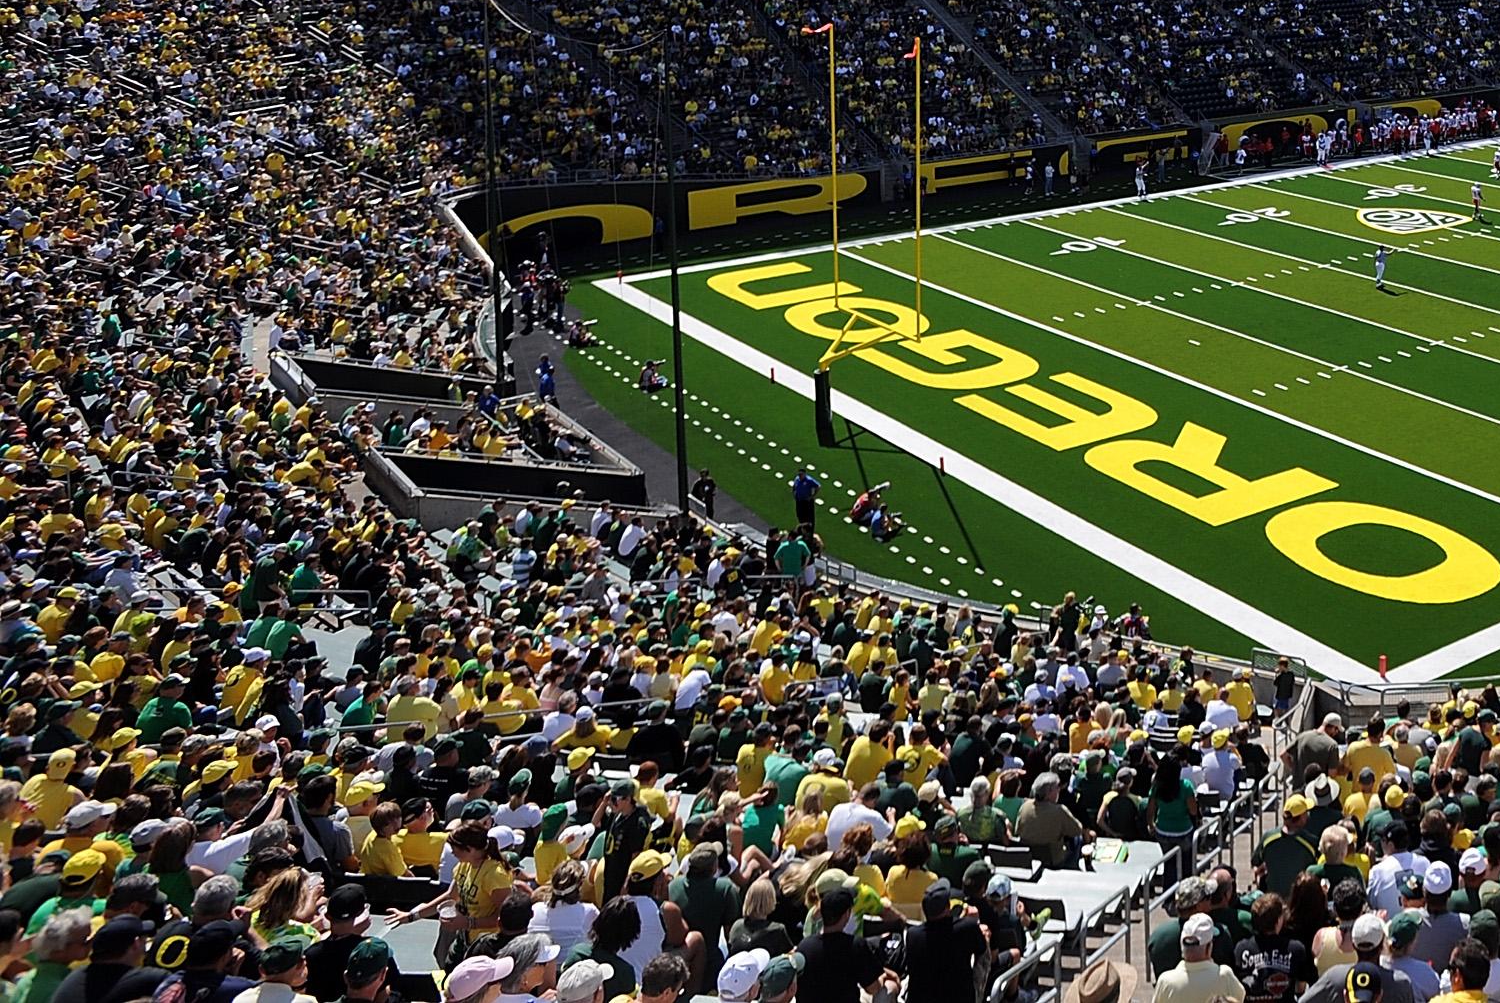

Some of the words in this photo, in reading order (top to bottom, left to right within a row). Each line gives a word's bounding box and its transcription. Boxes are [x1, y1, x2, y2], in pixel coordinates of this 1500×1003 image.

[1225, 207, 1291, 223] 20
[1062, 236, 1126, 252] 10
[155, 935, 190, 968] O
[1241, 950, 1269, 969] South
[1271, 948, 1293, 970] East
[1356, 972, 1370, 987] O
